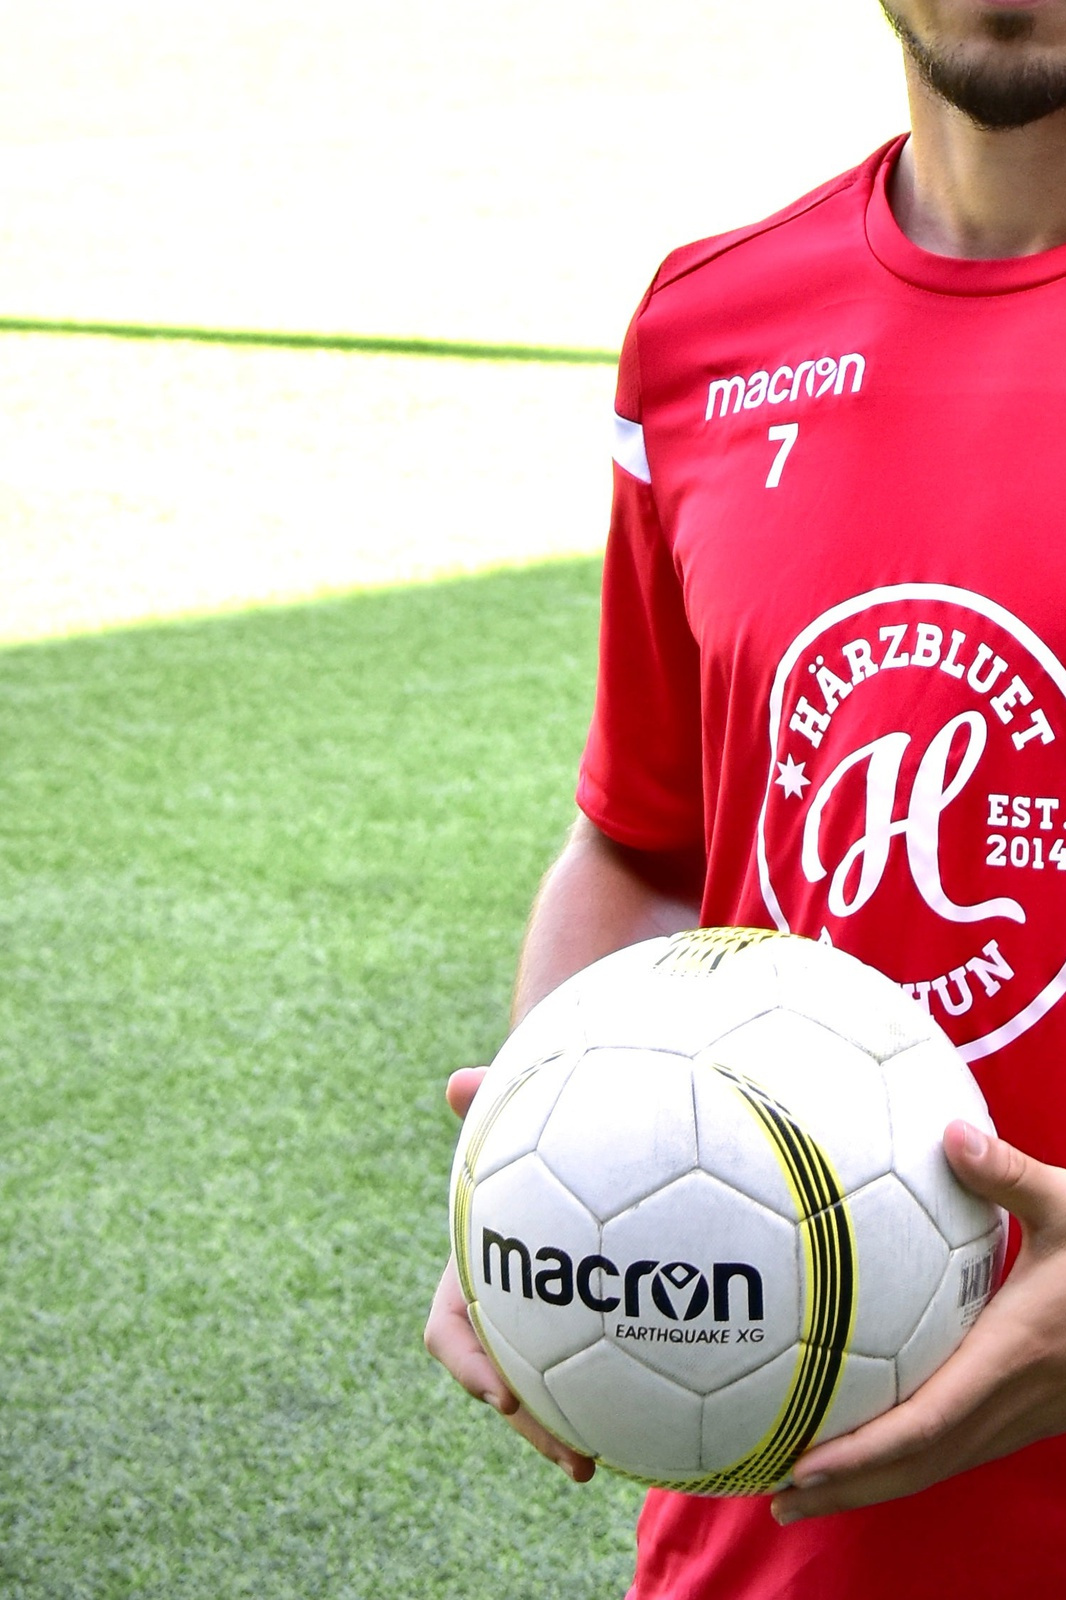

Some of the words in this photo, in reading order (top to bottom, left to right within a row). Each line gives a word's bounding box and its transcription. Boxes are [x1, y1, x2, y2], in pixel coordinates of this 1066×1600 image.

[704, 353, 866, 421] macron
[764, 424, 798, 489] 7
[789, 622, 1055, 751] HÄRZBLUET
[482, 1227, 764, 1321] macron
[615, 1324, 730, 1345] EARTHQUAKE
[735, 1329, 765, 1344] XG
